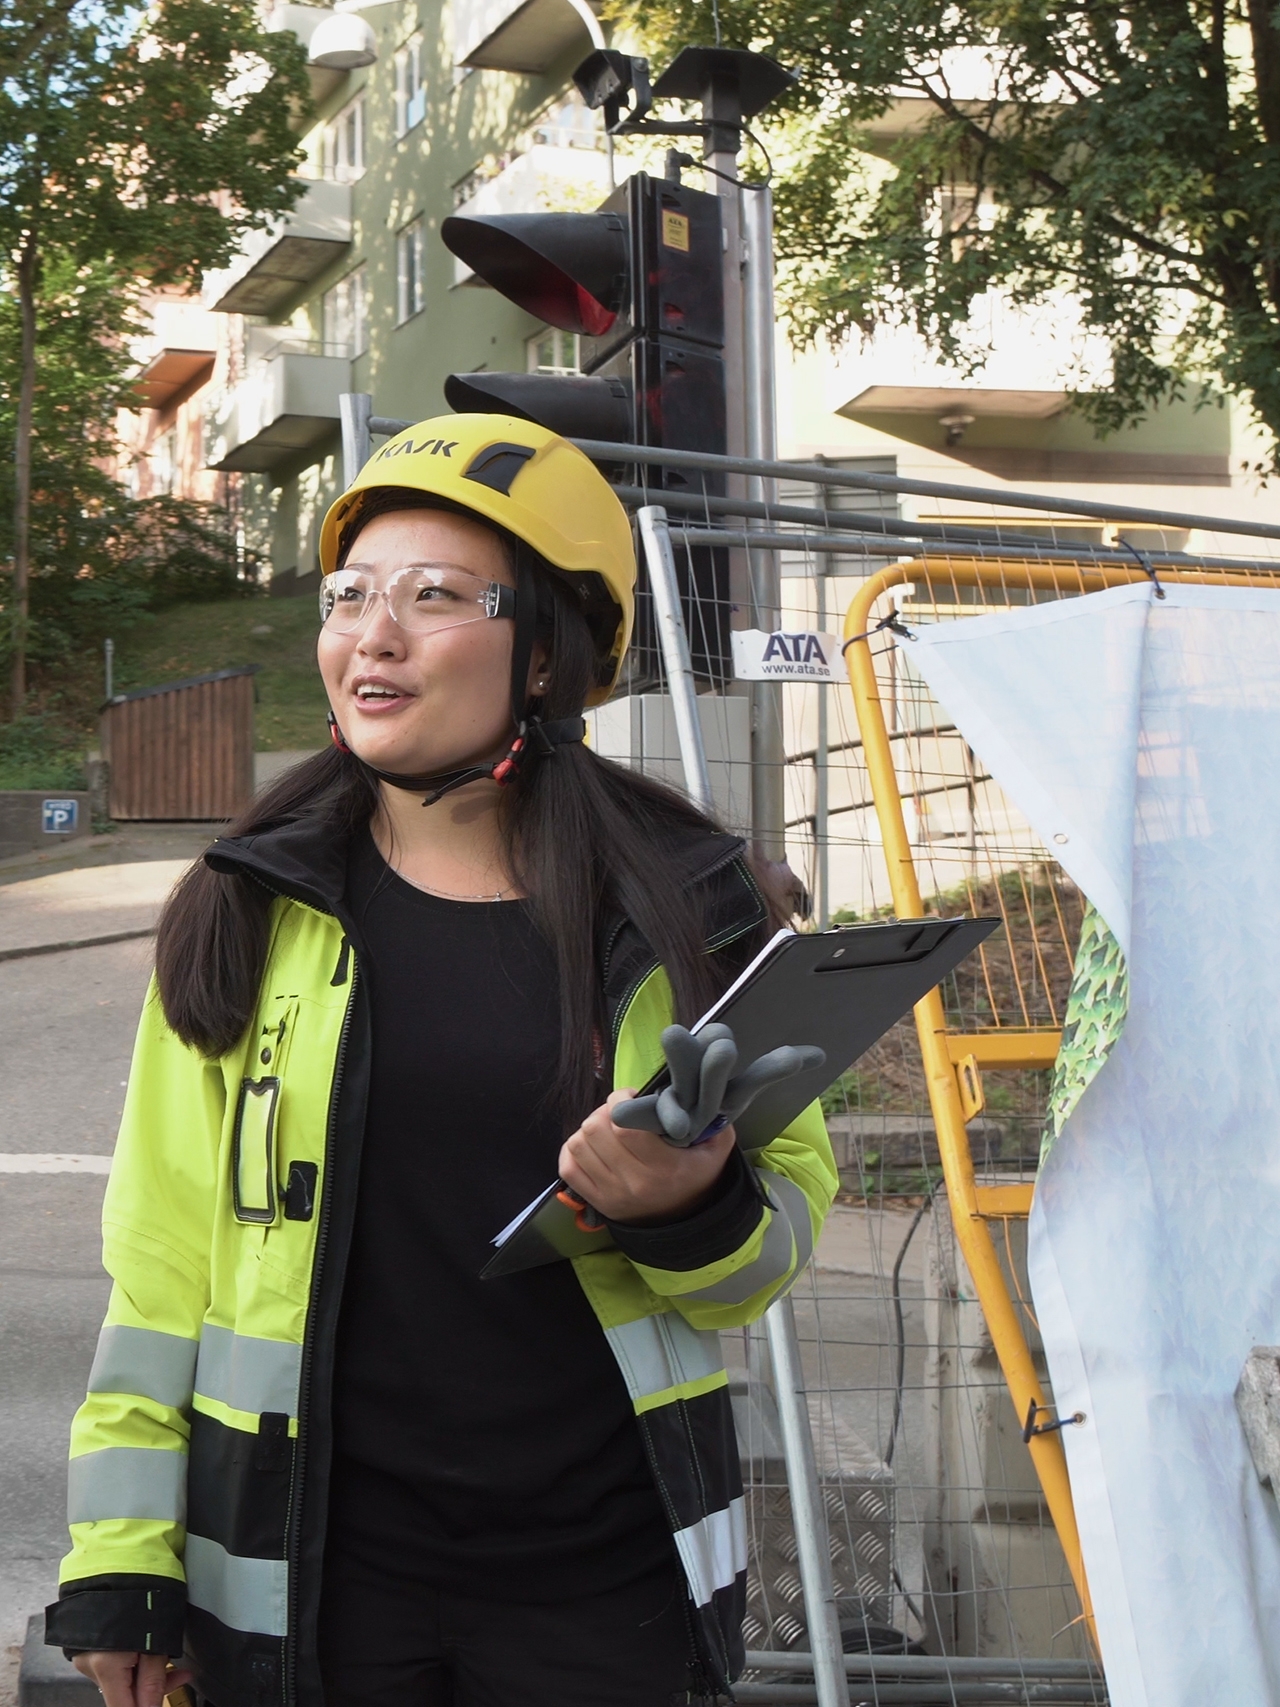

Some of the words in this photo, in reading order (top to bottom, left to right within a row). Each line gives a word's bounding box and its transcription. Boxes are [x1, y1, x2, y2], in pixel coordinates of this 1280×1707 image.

[375, 439, 459, 463] KASK
[762, 634, 828, 665] ATA
[762, 663, 831, 677] www.ata.se
[53, 810, 69, 830] P
